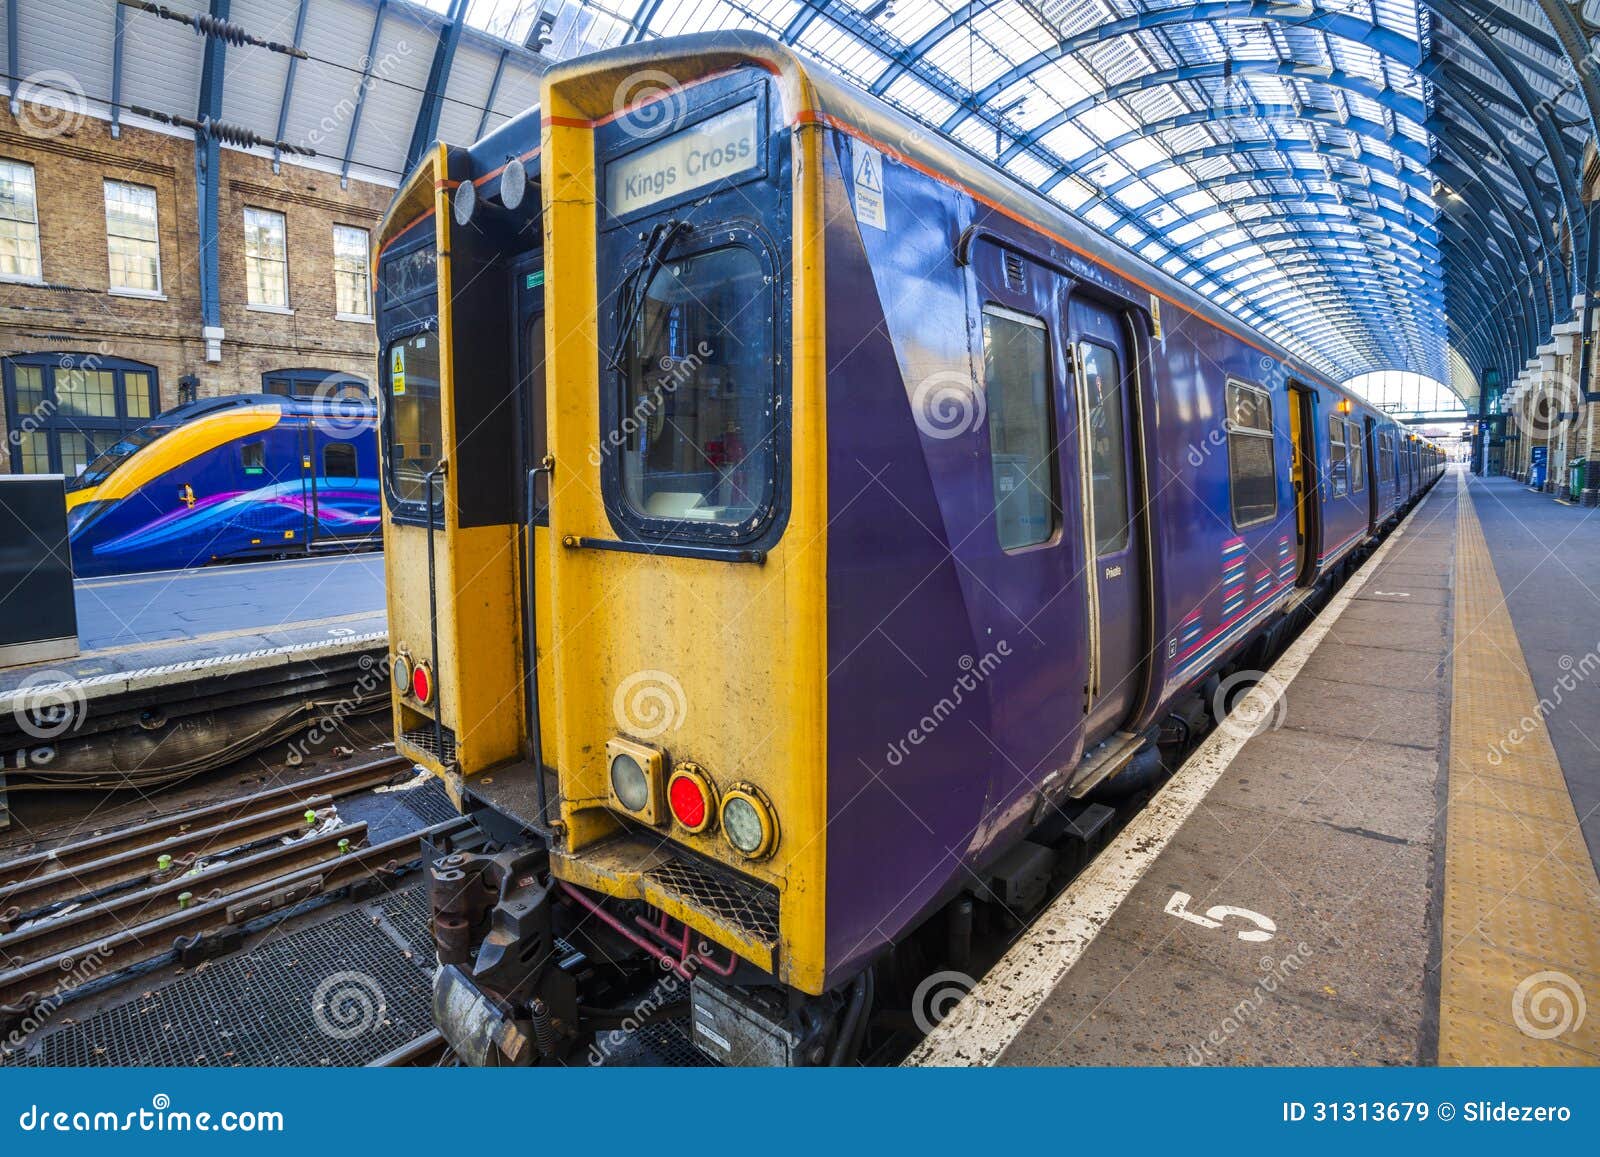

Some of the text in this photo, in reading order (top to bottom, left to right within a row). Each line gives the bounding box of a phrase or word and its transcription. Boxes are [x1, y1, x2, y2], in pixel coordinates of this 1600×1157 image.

[625, 137, 750, 200] Kings Cross
[1164, 892, 1277, 942] 5
